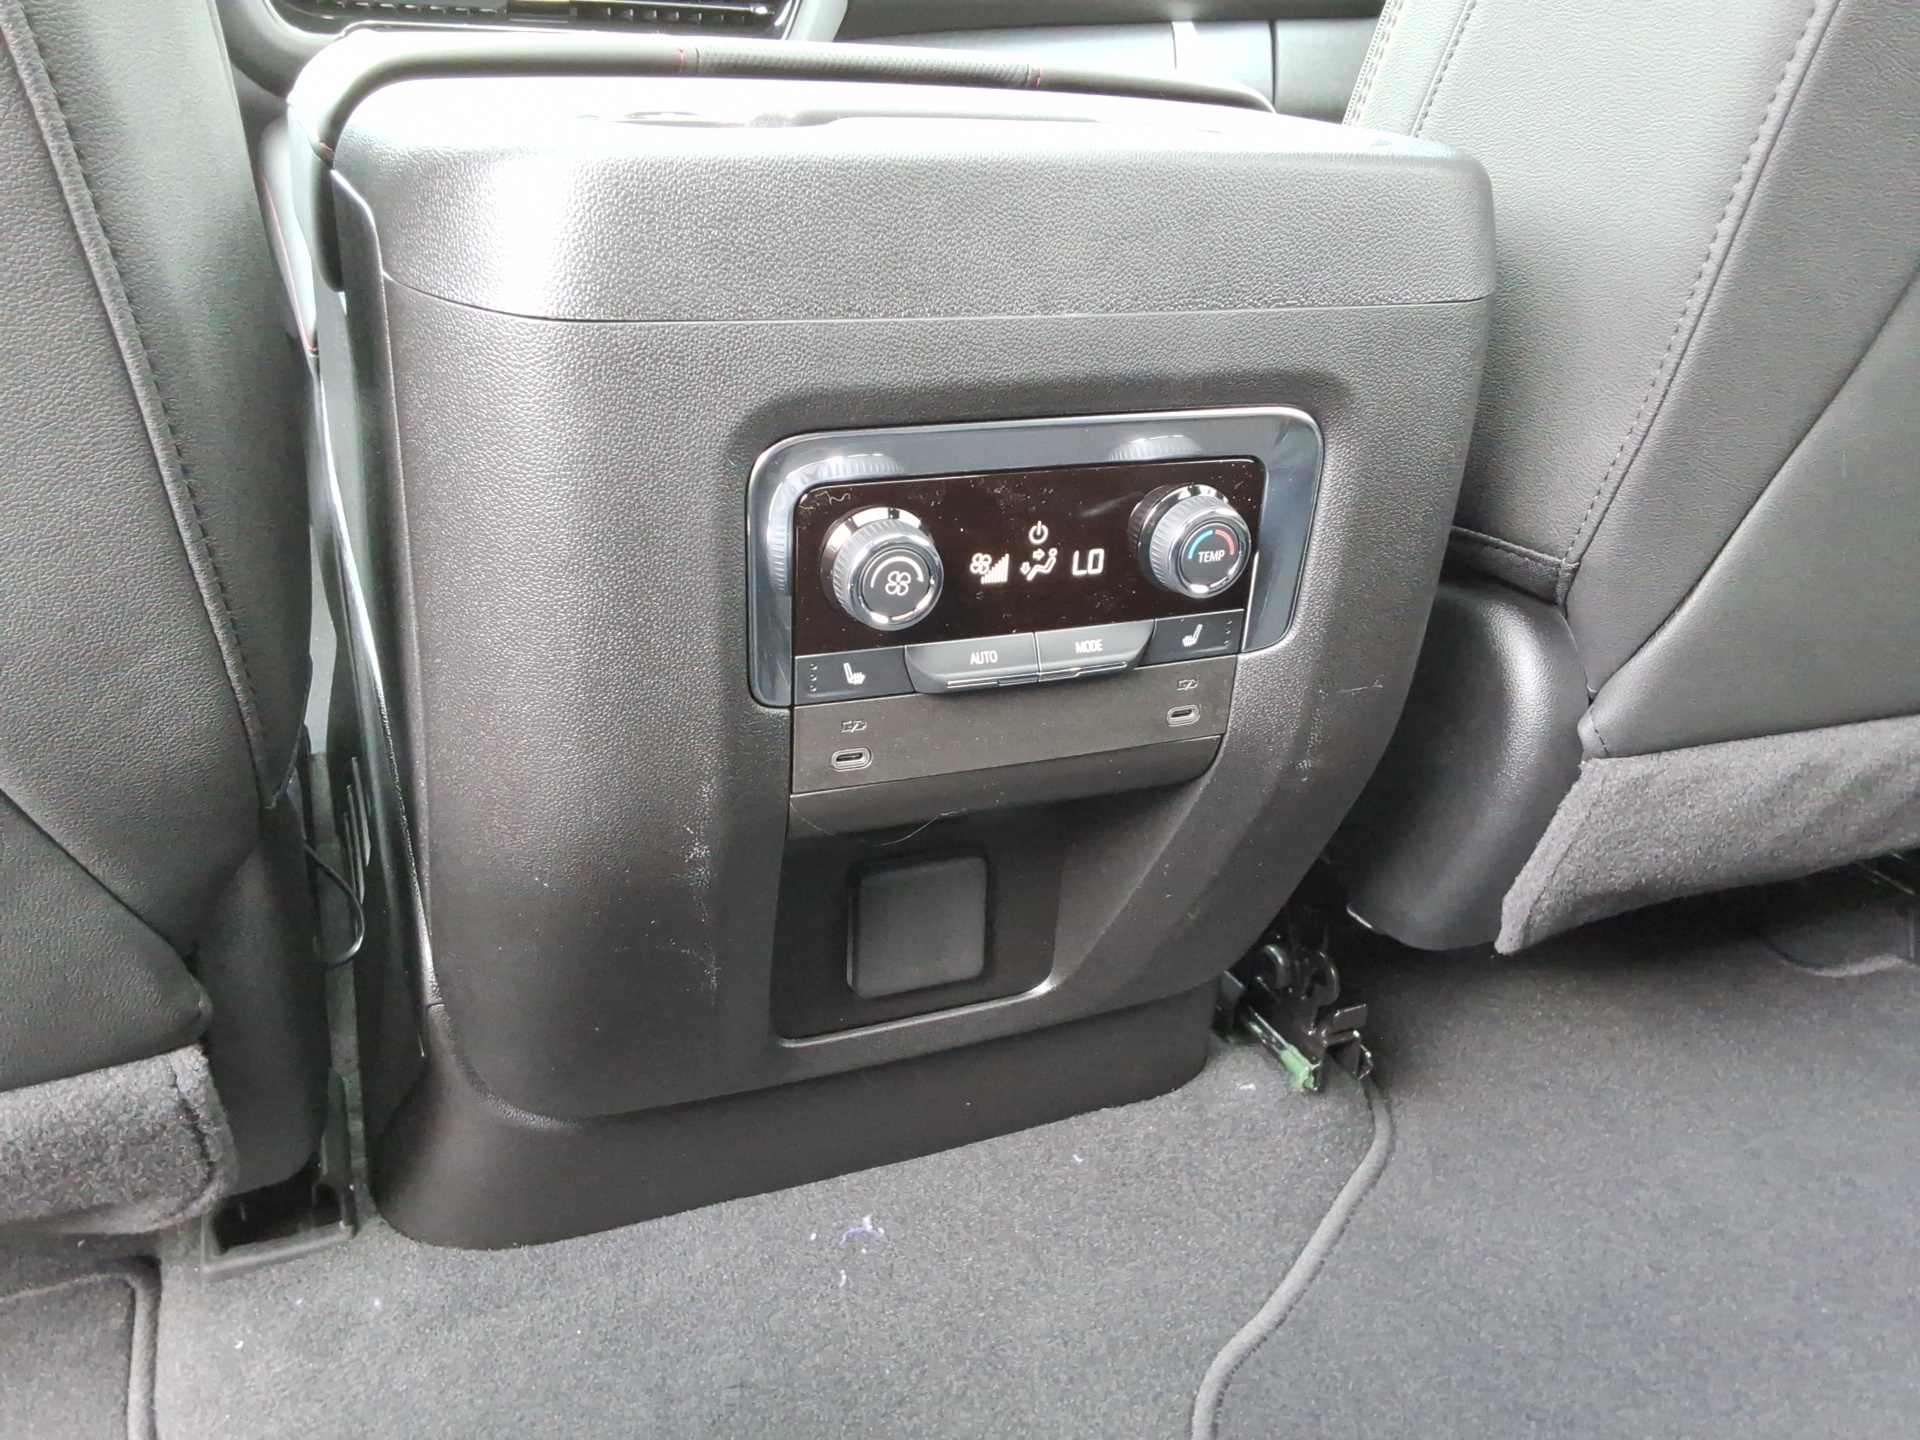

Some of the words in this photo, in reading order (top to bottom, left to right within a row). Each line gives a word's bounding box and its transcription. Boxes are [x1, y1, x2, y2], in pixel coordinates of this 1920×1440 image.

[1072, 548, 1105, 576] LO
[1198, 550, 1225, 563] TEMP
[1075, 639, 1103, 654] MODE
[970, 650, 998, 665] AUTO
